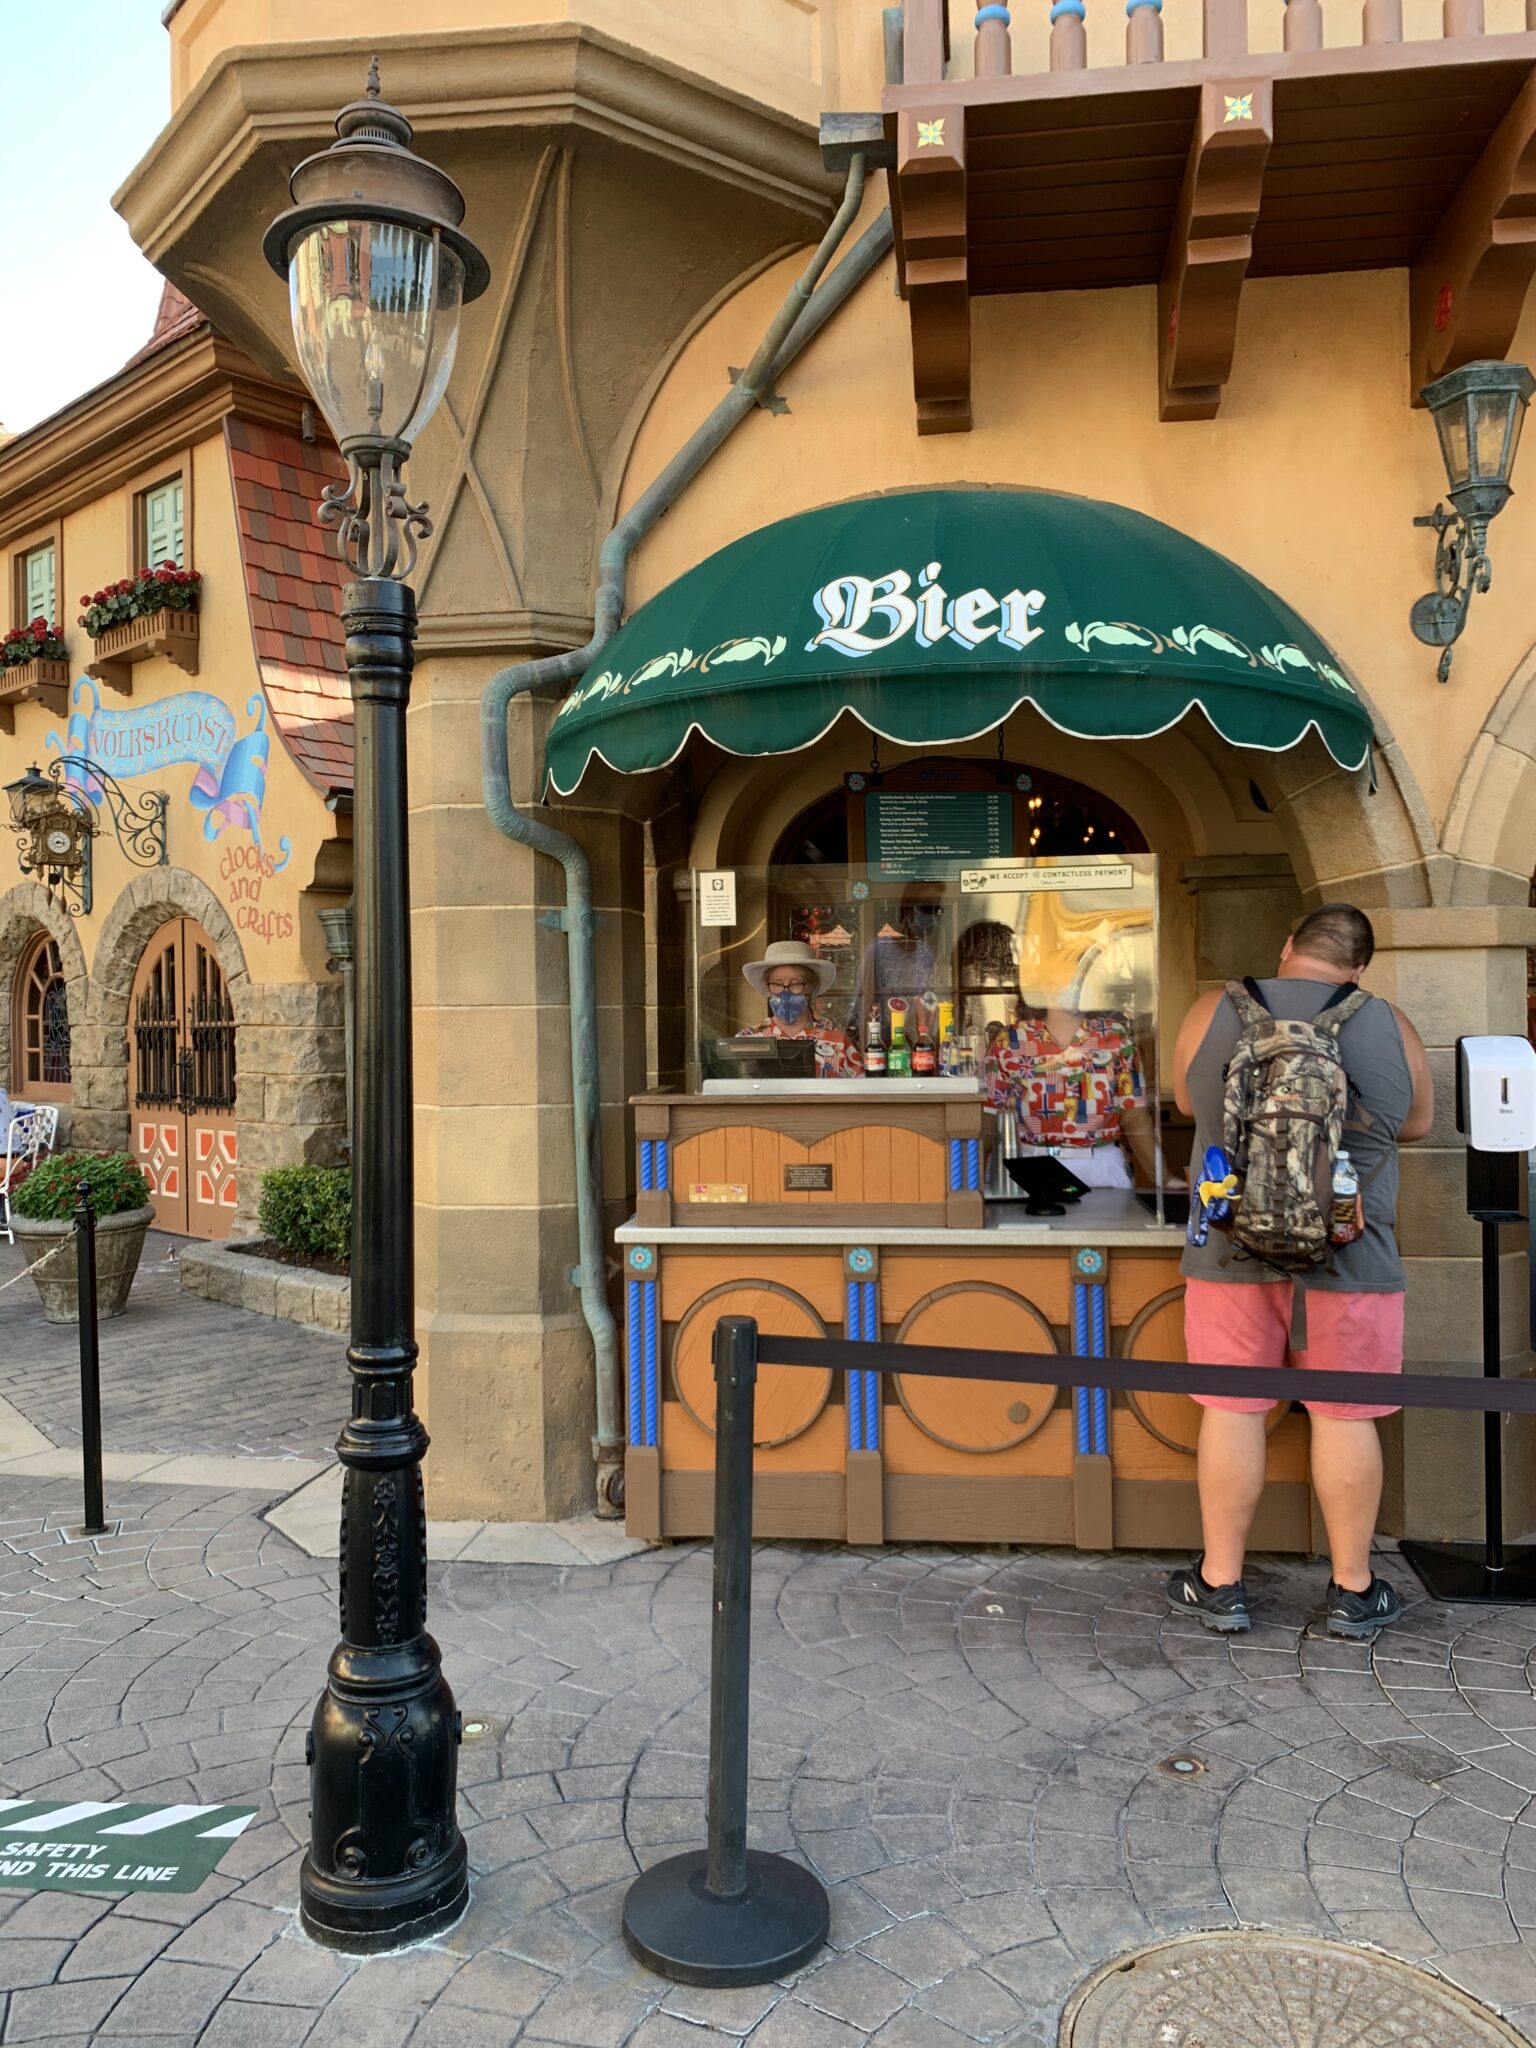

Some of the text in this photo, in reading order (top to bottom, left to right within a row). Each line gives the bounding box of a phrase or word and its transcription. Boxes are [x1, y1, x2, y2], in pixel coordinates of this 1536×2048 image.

[804, 561, 1047, 658] Bier
[91, 712, 227, 758] VOLKSKUNST
[1042, 870, 1092, 878] CONTACTLESS
[229, 876, 263, 903] and
[0, 1842, 108, 1859] SAFETY
[44, 1862, 111, 1879] THIS
[113, 1864, 180, 1881] LINE
